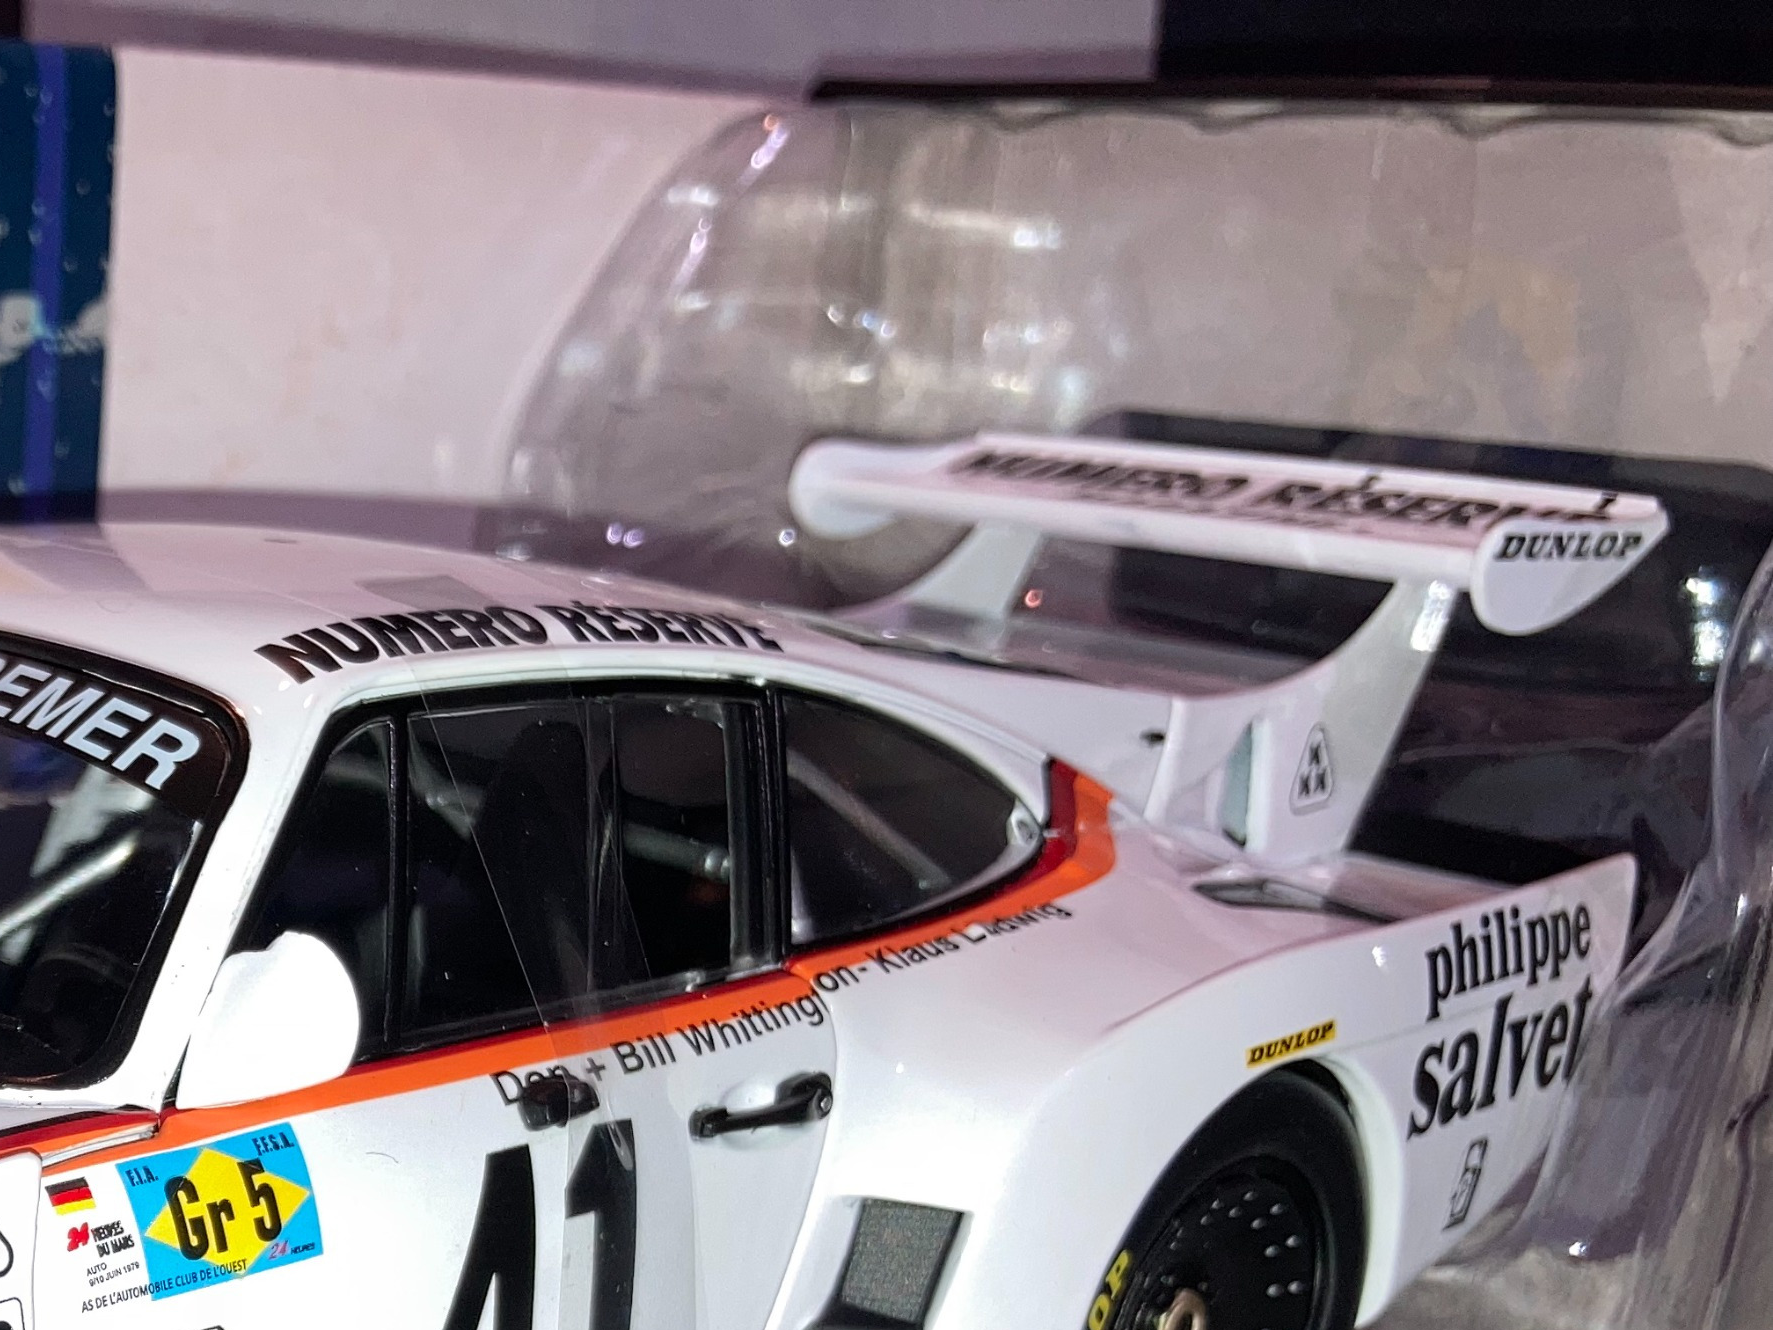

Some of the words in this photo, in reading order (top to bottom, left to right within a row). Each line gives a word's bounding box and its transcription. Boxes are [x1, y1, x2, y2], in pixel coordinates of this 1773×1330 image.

[1494, 533, 1643, 562] DUNLOP
[254, 606, 548, 685] NUMERO
[1425, 901, 1591, 1024] philippe
[610, 1032, 678, 1076] Bill
[866, 937, 960, 974] Klaus
[1247, 1020, 1334, 1066] DUNLOP
[1407, 973, 1593, 1141] salvet
[164, 1175, 236, 1261] Gr
[236, 1157, 283, 1242] 5
[81, 1299, 94, 1313] AS
[95, 1295, 108, 1310] DE
[109, 1277, 174, 1305] L'AUTOMOBILE
[175, 1271, 199, 1288] CLUB
[200, 1267, 212, 1281] DE
[213, 1258, 248, 1278] L'OUEST
[86, 1262, 108, 1277] AUTO
[105, 1267, 122, 1281] JUIN
